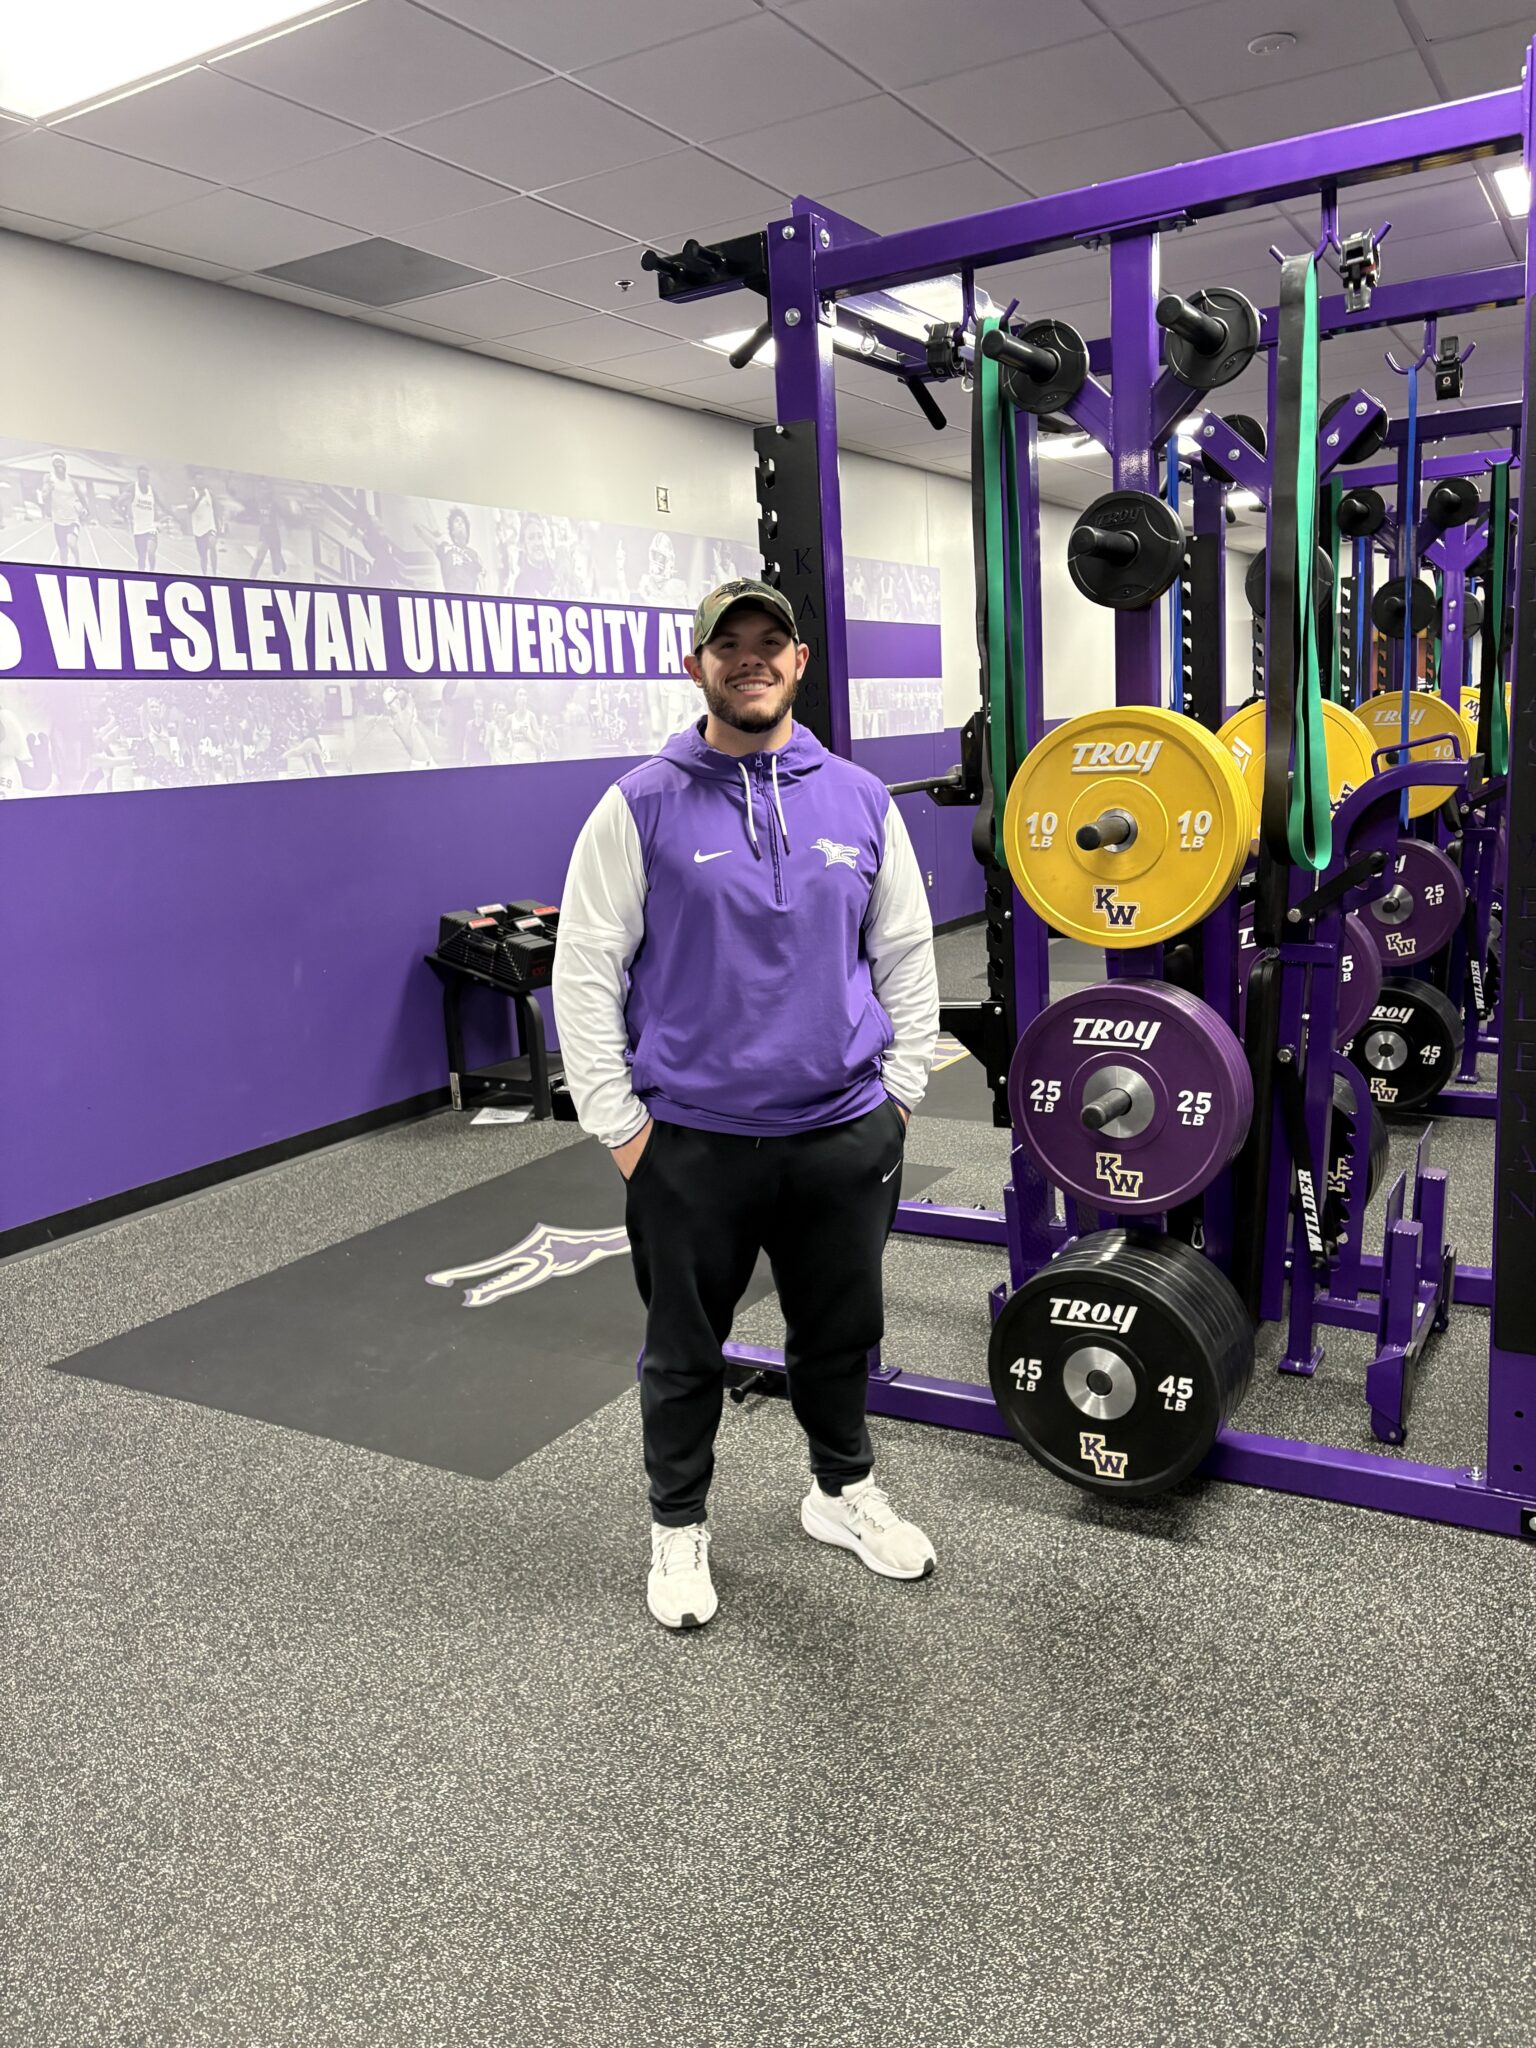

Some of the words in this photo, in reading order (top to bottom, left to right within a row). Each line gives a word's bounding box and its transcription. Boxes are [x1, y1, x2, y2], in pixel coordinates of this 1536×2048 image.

[35, 573, 388, 672] WESLEYAN
[397, 596, 648, 674] UNIVERSITY
[658, 612, 694, 674] AT
[1373, 708, 1426, 726] TRY
[1072, 741, 1162, 774] TROY
[1026, 811, 1058, 835] 10
[1177, 810, 1213, 835] 10
[1030, 834, 1054, 850] LB
[1180, 834, 1207, 850] LB
[1425, 883, 1445, 901] 25
[1429, 897, 1443, 907] LB
[1093, 885, 1140, 929] KW
[1385, 932, 1416, 957] KW
[1470, 959, 1486, 1010] WILDER
[1369, 1005, 1415, 1024] ROY
[1072, 1017, 1161, 1051] TROY
[1419, 1044, 1442, 1059] 45
[1030, 1079, 1061, 1102] 25
[1370, 1077, 1399, 1103] KW
[1034, 1101, 1055, 1114] LB
[1177, 1090, 1212, 1116] 25
[1182, 1113, 1206, 1127] LB
[1096, 1152, 1143, 1198] KW
[1297, 1168, 1324, 1253] WILDER
[1049, 1297, 1138, 1333] TROY
[1009, 1357, 1043, 1381] 45
[1015, 1379, 1036, 1393] LB
[1158, 1375, 1193, 1401] 45
[1164, 1397, 1187, 1412] LB
[1079, 1432, 1128, 1479] KW
